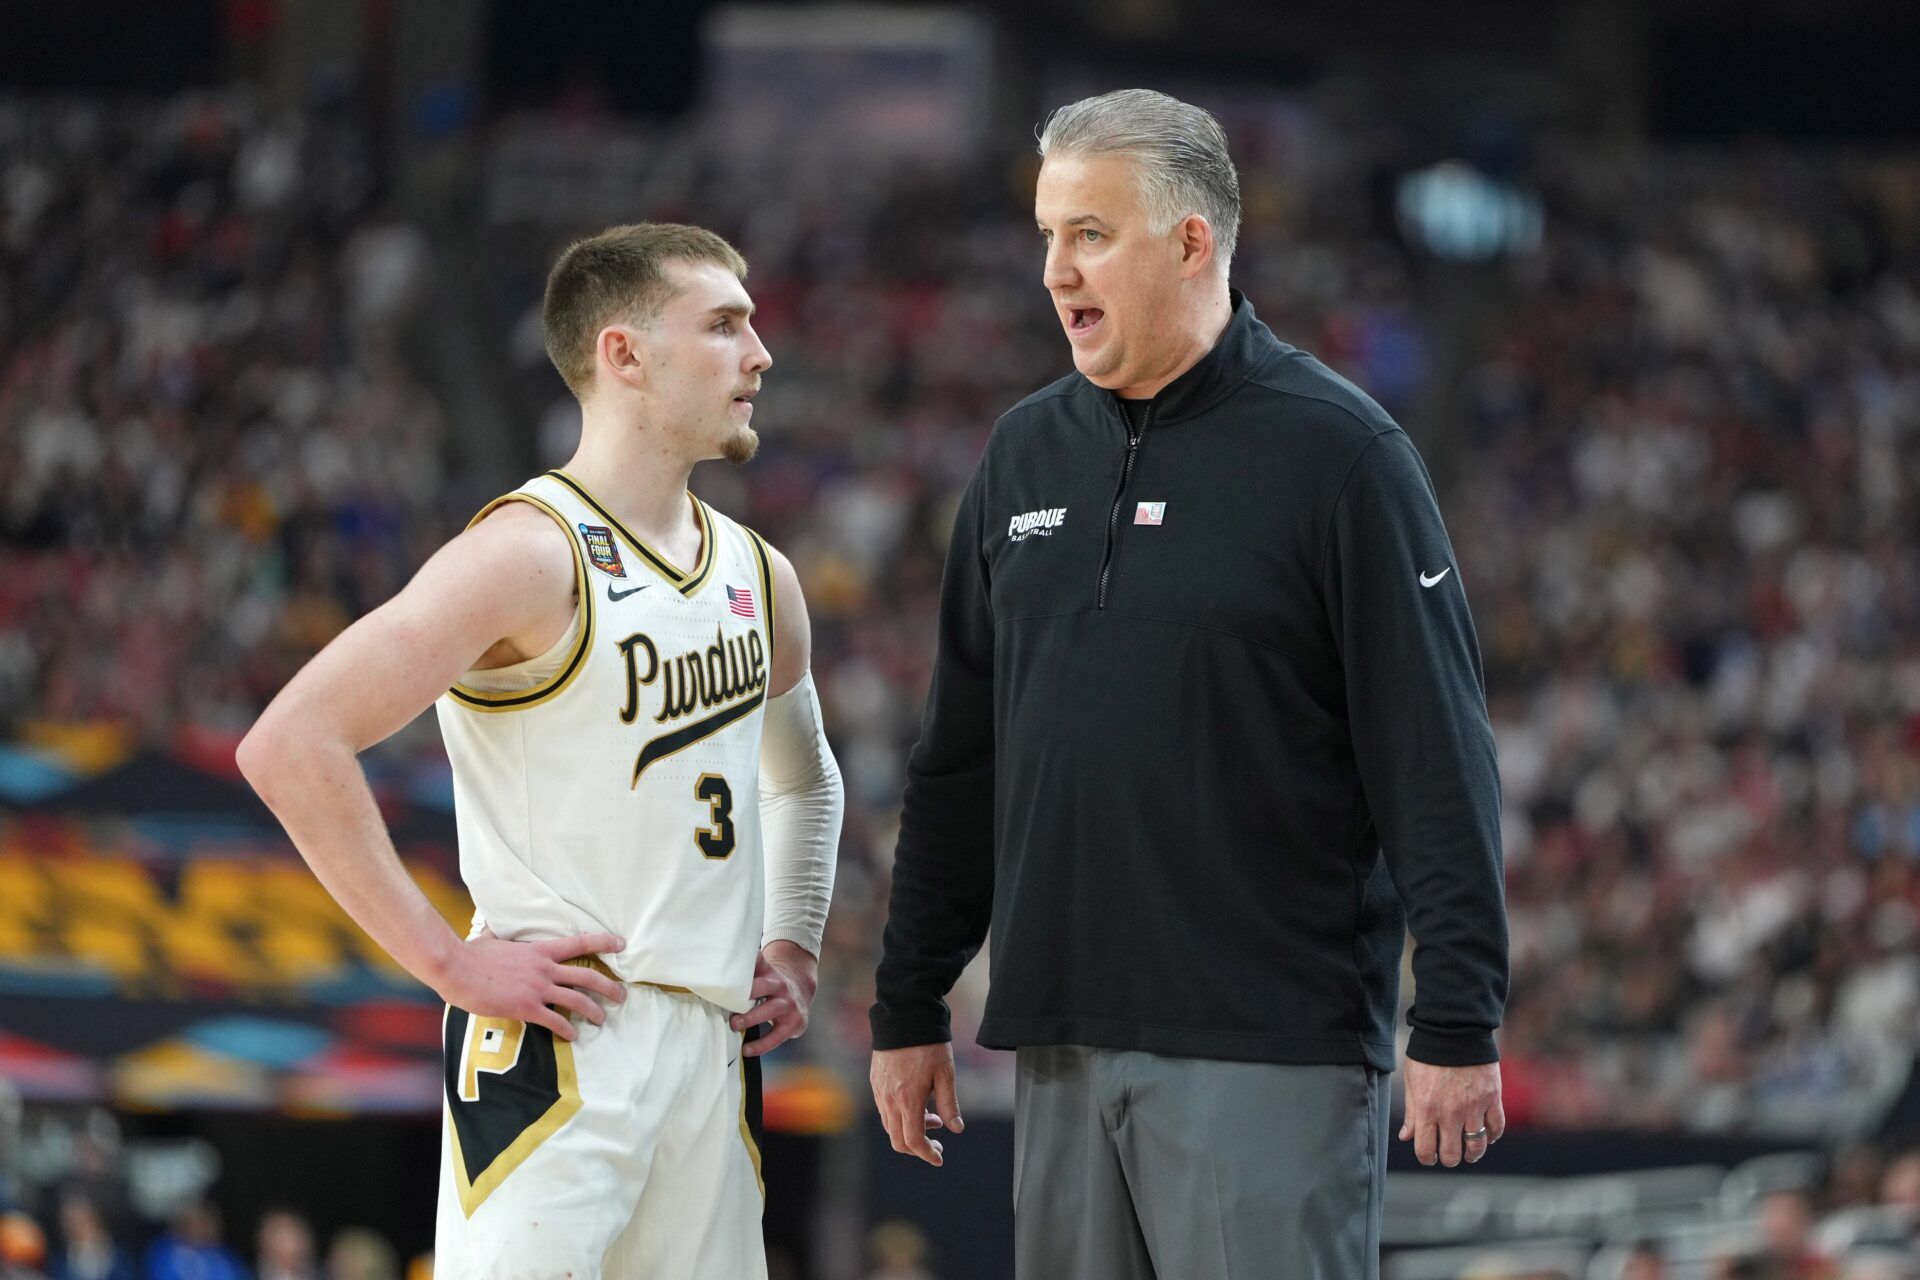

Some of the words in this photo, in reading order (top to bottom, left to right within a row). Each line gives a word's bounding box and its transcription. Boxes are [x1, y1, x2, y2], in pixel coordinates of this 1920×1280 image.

[1008, 508, 1067, 536] PURDUE
[1011, 528, 1053, 541] BASTBALL
[587, 534, 610, 546] FINAL
[590, 545, 612, 557] FOUR
[615, 621, 766, 725] Purdue
[694, 772, 735, 860] 3
[457, 1013, 526, 1102] P
